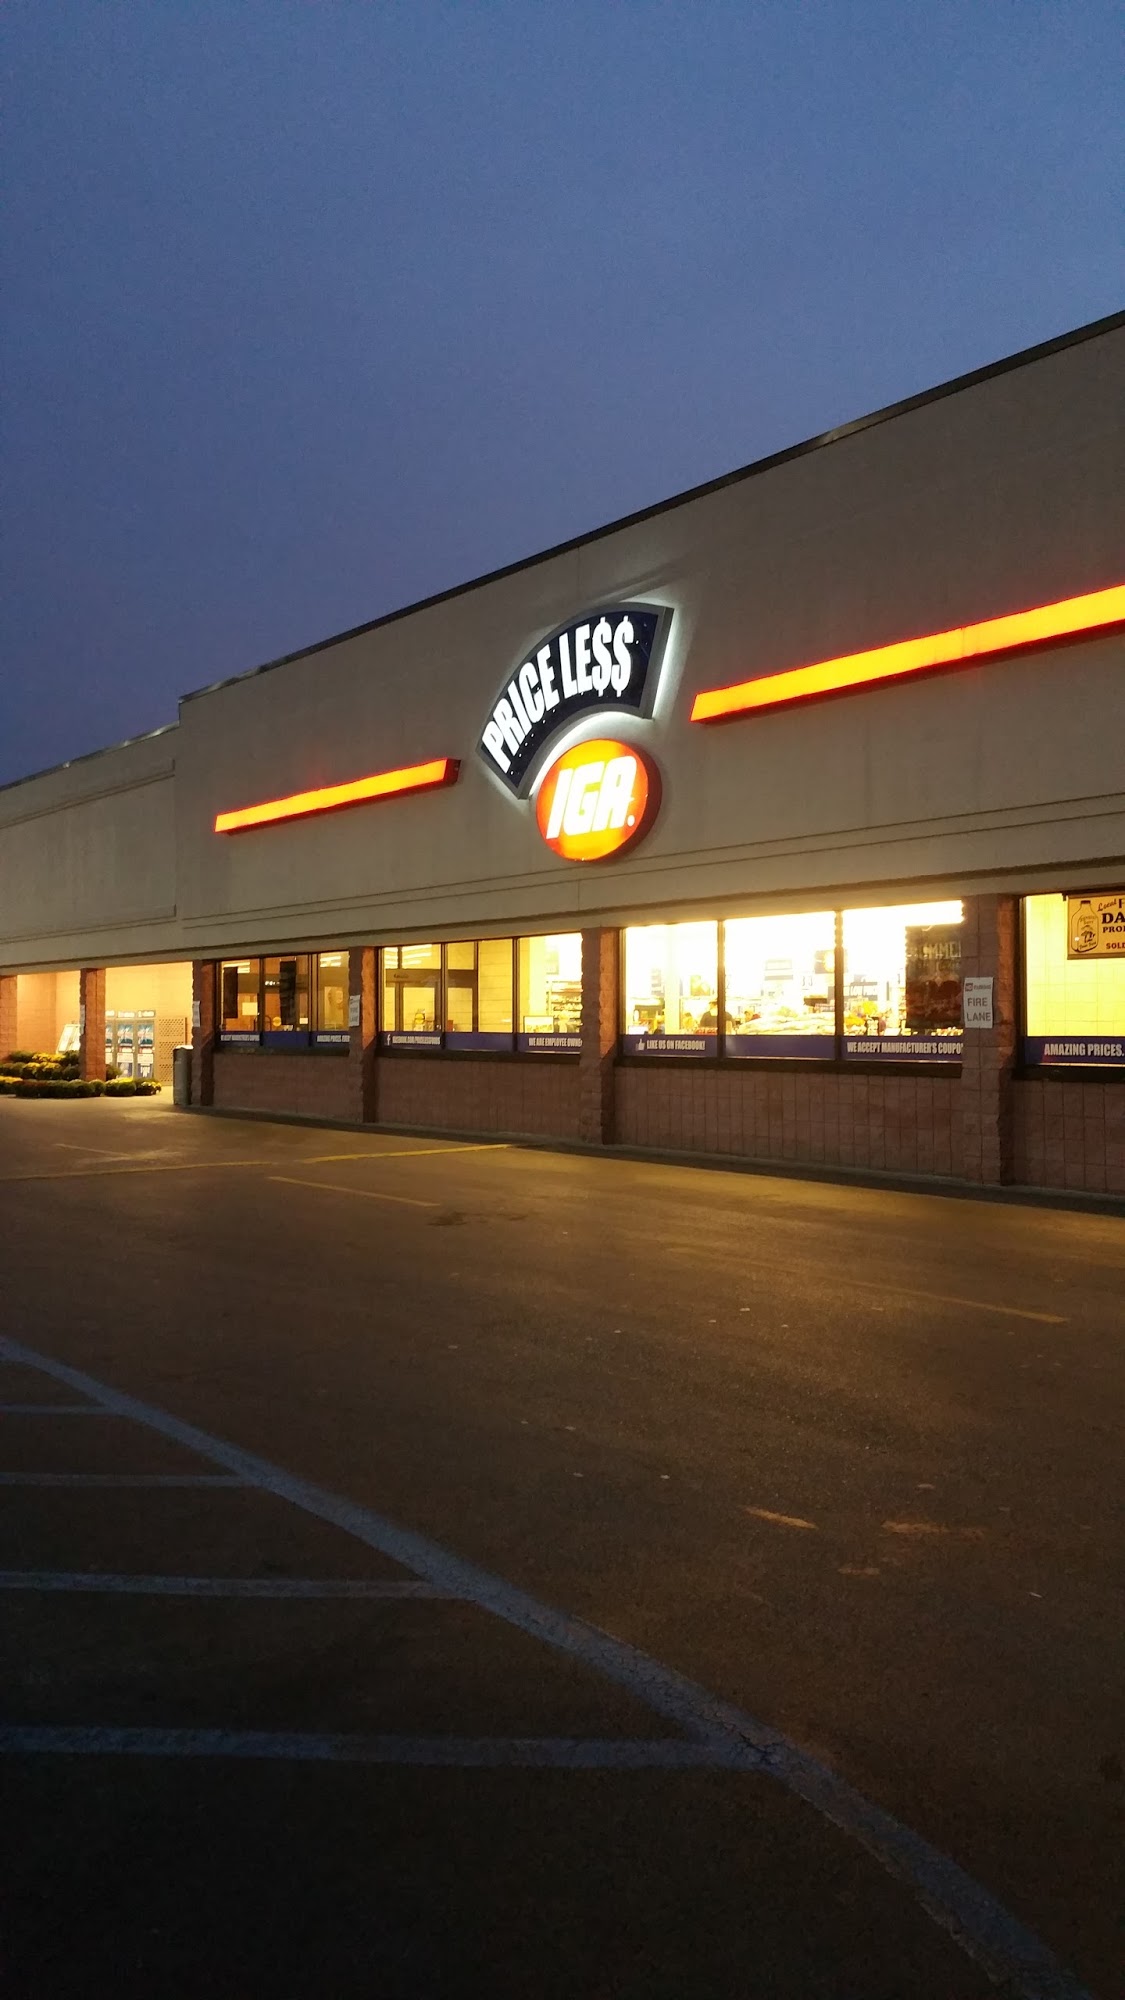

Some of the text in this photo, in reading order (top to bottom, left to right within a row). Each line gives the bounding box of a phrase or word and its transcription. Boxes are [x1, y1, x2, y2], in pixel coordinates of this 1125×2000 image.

[482, 644, 560, 773] PRICE
[967, 997, 988, 1006] FIRE
[966, 1012, 991, 1022] LANE
[646, 1040, 658, 1050] LIKE
[658, 1040, 666, 1050] US
[666, 1040, 675, 1050] ON
[847, 1041, 858, 1053] WE
[857, 1041, 881, 1053] ACCEPT
[1044, 1043, 1125, 1057] AMAZING PRICES.
